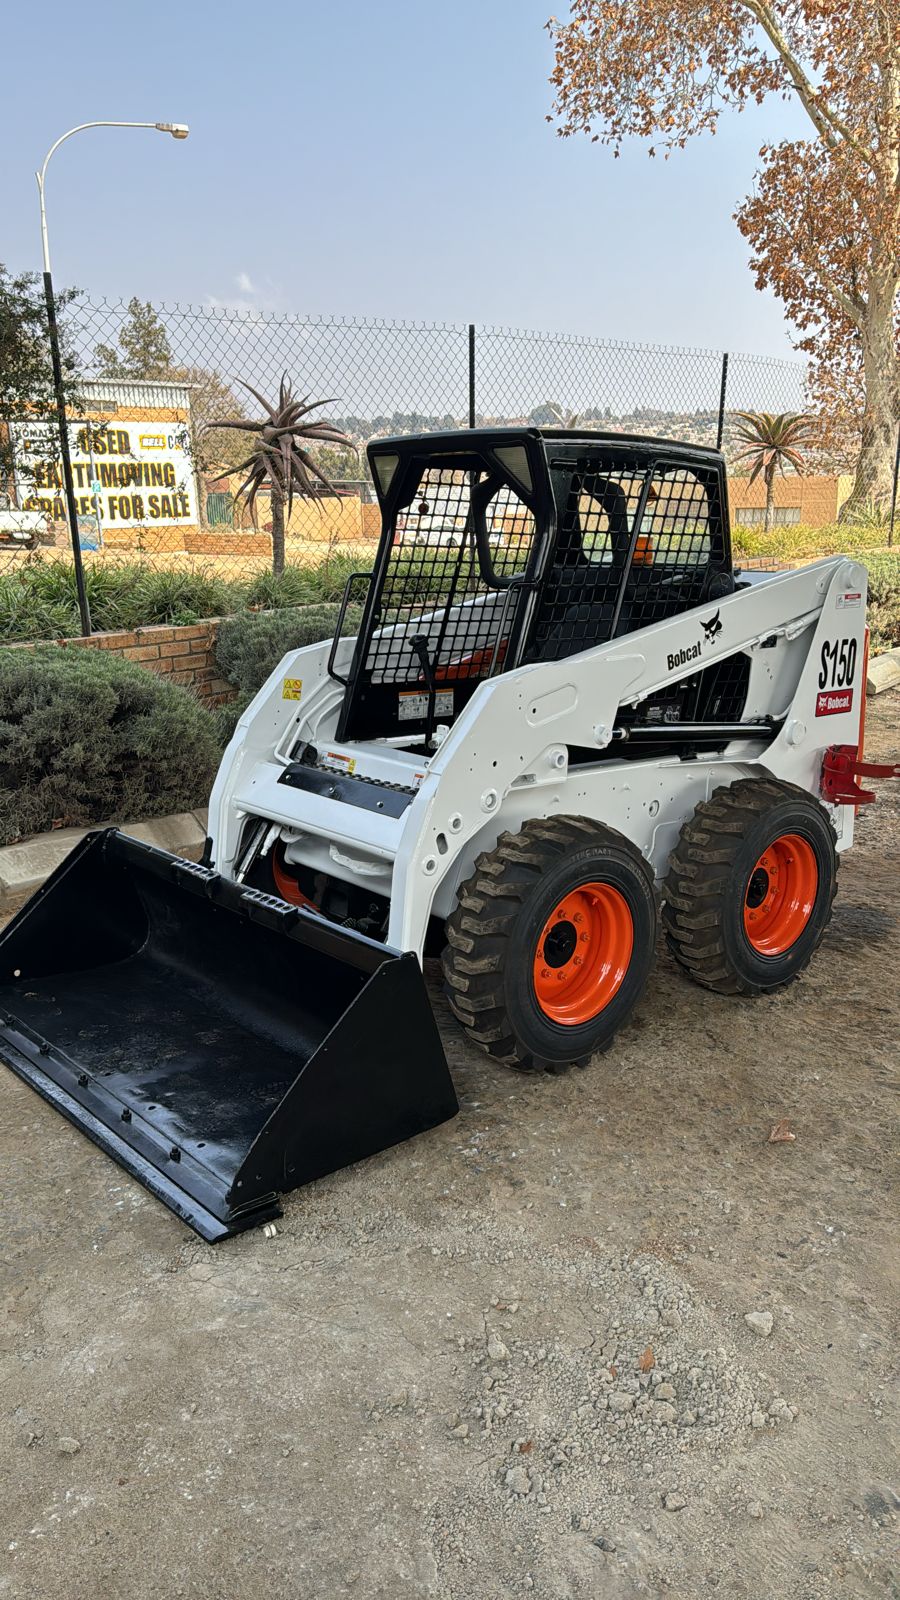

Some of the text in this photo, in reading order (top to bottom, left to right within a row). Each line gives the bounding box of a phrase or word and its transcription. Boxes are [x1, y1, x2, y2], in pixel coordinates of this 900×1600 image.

[79, 429, 131, 455] USED
[108, 495, 146, 520] FOR
[148, 494, 191, 519] SALE
[666, 640, 702, 671] Bobcat
[819, 638, 857, 690] S150
